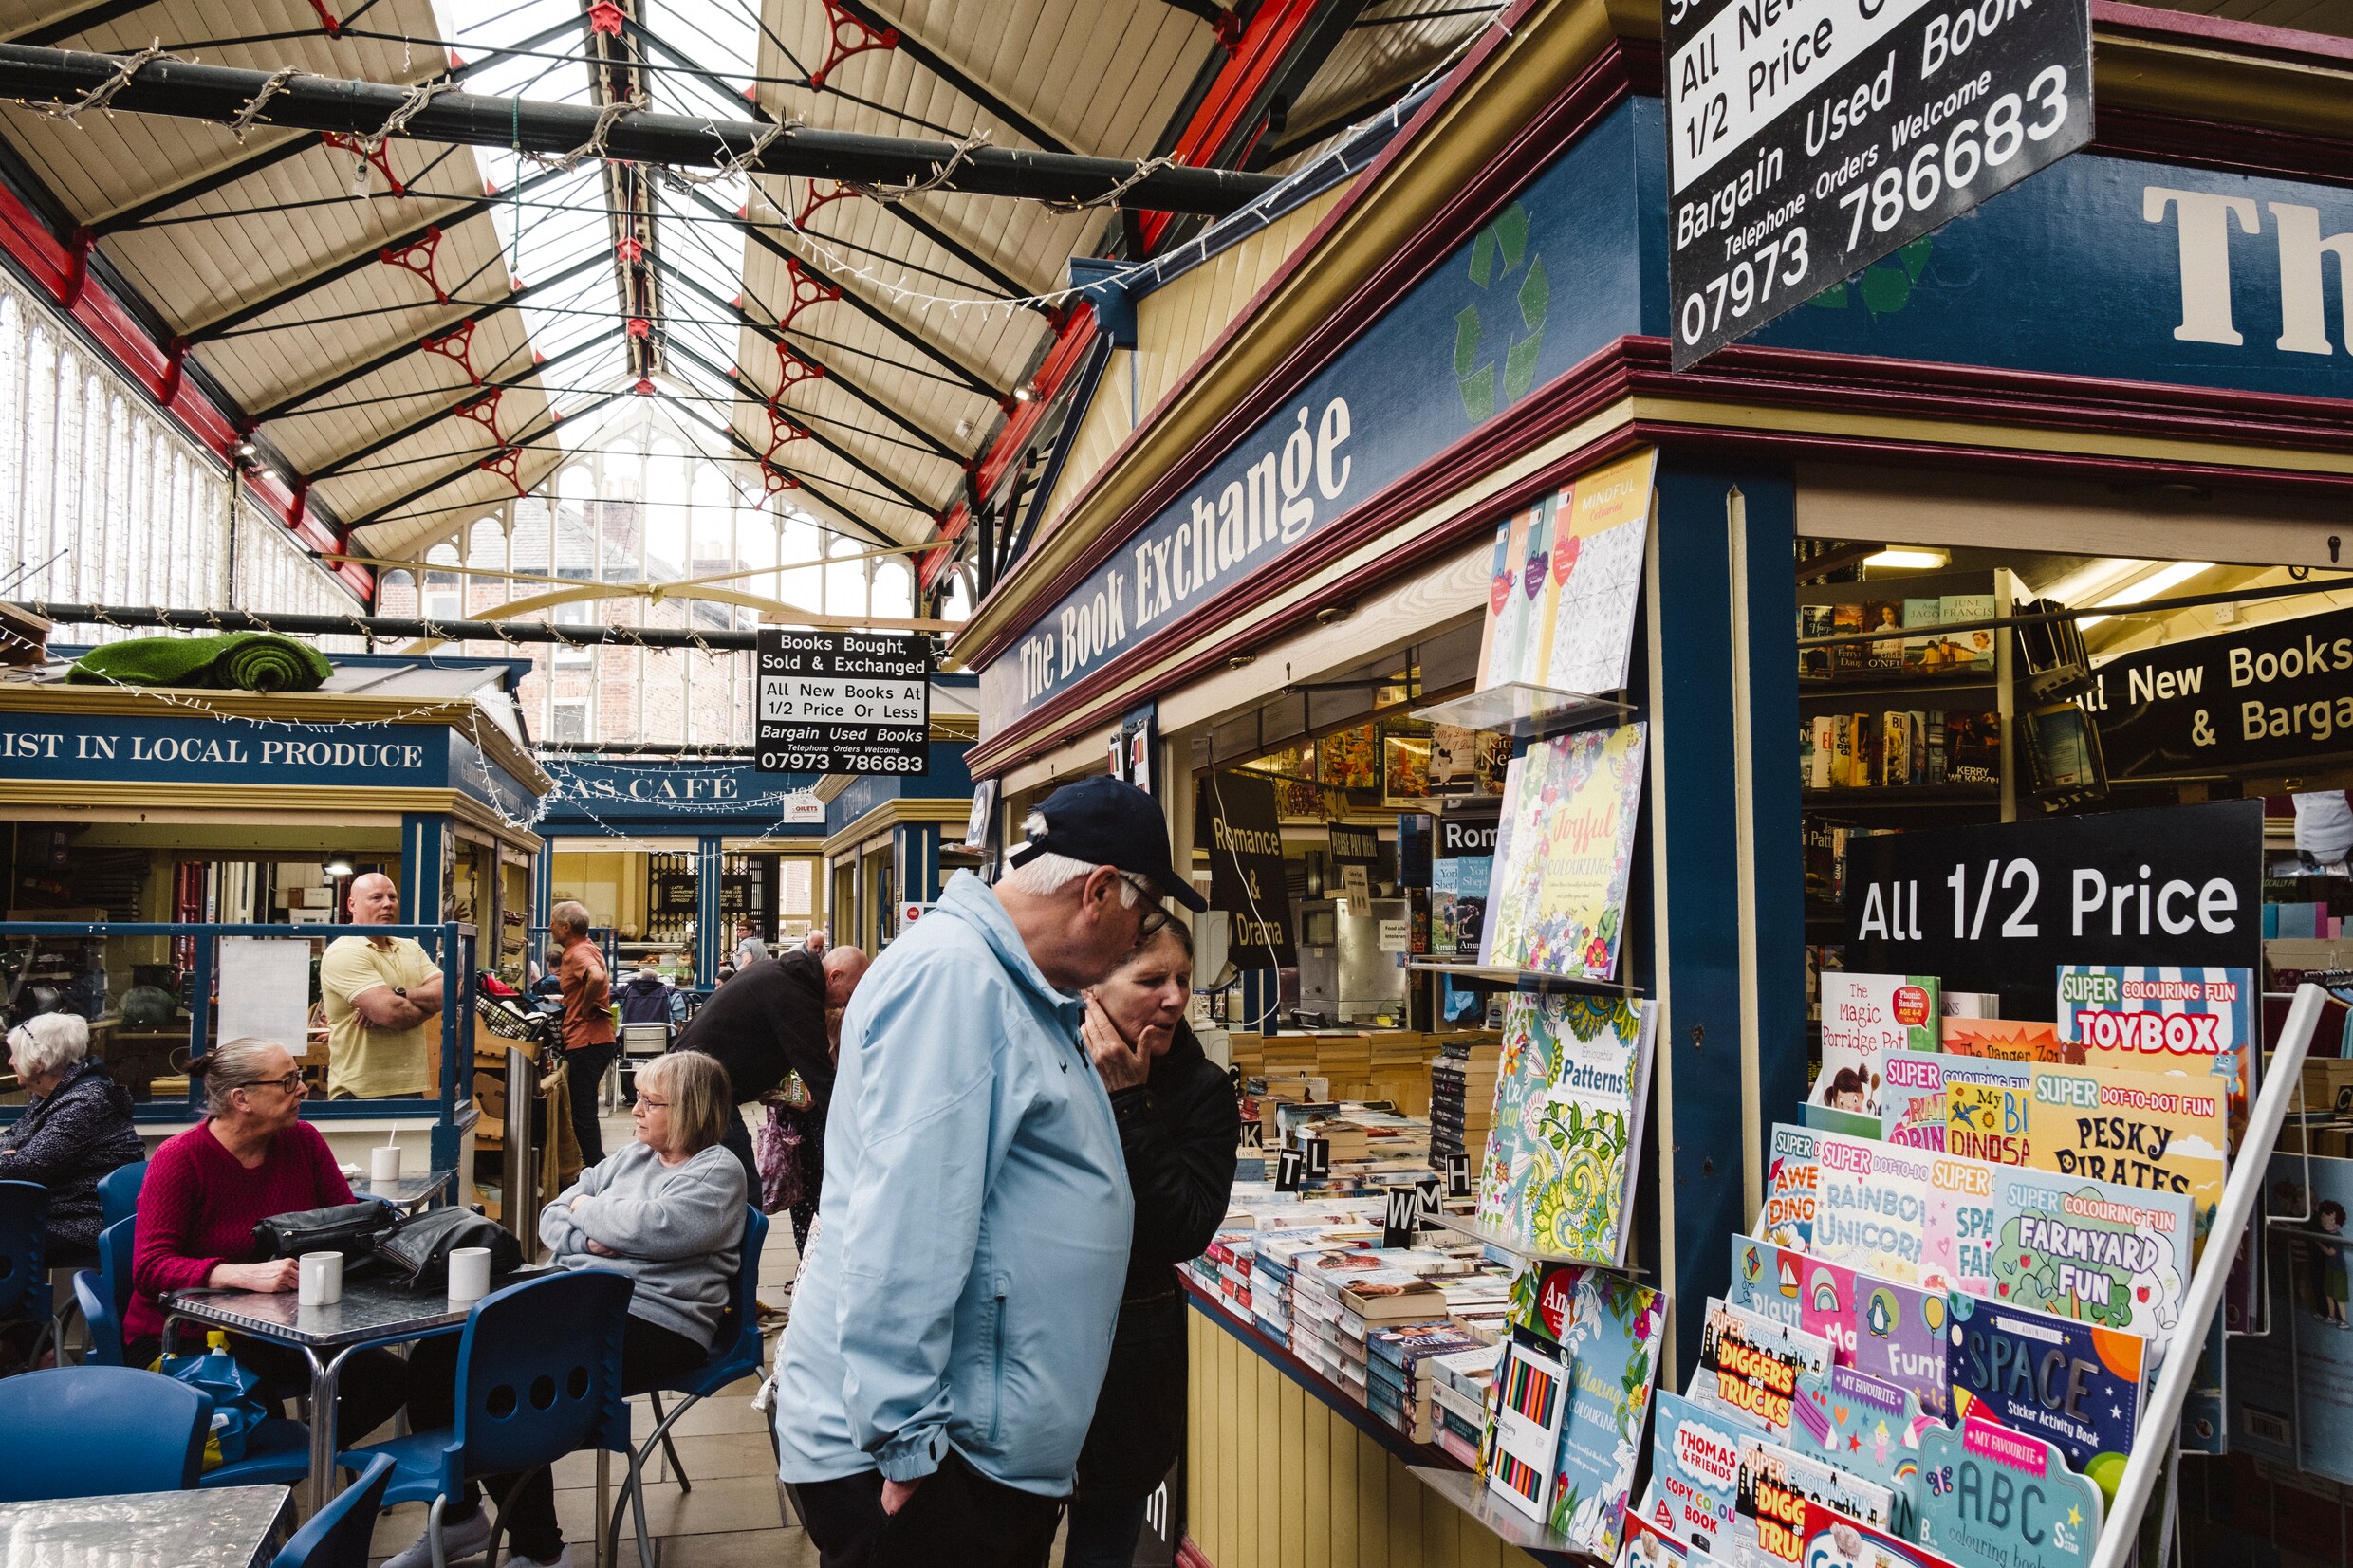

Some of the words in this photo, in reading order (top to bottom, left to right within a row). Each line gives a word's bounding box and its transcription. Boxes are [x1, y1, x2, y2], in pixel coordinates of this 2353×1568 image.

[1681, 32, 1719, 103] All
[1686, 92, 1728, 160] 1/2
[1748, 17, 1833, 112] Price
[1677, 147, 1783, 251] Bargain
[1806, 50, 1896, 157] Used
[1725, 194, 1805, 261] Telephone
[1816, 144, 1879, 199] Orders
[1891, 70, 1992, 151] Welcome
[1681, 226, 1809, 345] 07973
[1840, 65, 2068, 252] 786683
[1583, 478, 1635, 512] MINDFUL
[1019, 635, 1055, 705] The
[1060, 571, 1126, 681] Book
[1135, 397, 1352, 630] Exchange
[1943, 608, 1992, 617] FRANCIS
[1955, 599, 1981, 607] JUNE
[781, 635, 833, 652] Books
[843, 637, 907, 655] Bought,
[762, 654, 801, 670] Sold
[811, 656, 824, 671] &
[835, 656, 925, 676] Exchanged
[2128, 665, 2204, 705] New
[2230, 635, 2353, 689] Books
[767, 682, 789, 696] All
[800, 683, 835, 697] New
[844, 685, 894, 699] Books
[903, 687, 921, 700] At
[769, 701, 793, 715] 1/2
[804, 702, 843, 716] Price
[854, 704, 874, 717] Or
[884, 705, 918, 719] Less
[761, 725, 820, 741] Bargain
[829, 727, 867, 741] Used
[877, 729, 923, 742] Books
[2192, 709, 2216, 747] &
[76, 734, 120, 760] IN
[131, 736, 248, 764] LOCAL
[259, 740, 423, 768] PRODUCE
[761, 752, 830, 770] 07973
[843, 754, 923, 772] 786683
[787, 744, 828, 752] Telephone
[833, 745, 861, 753] Orders
[864, 745, 900, 754] Welcome
[629, 774, 738, 799] CAFÉ
[1956, 766, 1990, 777] KERRY
[1213, 817, 1279, 856] Romance
[1331, 831, 1350, 856] PLEASE
[1349, 833, 1362, 857] PAY
[1553, 802, 1617, 854] Joyful
[1547, 858, 1607, 876] COLOURING
[1250, 869, 1261, 900] &
[1858, 878, 1922, 941] All
[1947, 858, 2040, 941] 1/2
[2071, 864, 2238, 938] Price
[1236, 913, 1283, 946] Drama
[1850, 983, 1867, 998] The
[1898, 999, 1924, 1009] Readers
[1899, 989, 1921, 1000] Phonic
[2062, 974, 2119, 1004] SUPER
[2121, 982, 2201, 1002] COLOURING
[2204, 982, 2237, 1002] FUN
[1839, 1003, 1881, 1028] Magic
[1899, 1008, 1912, 1017] AGE
[1823, 1025, 1878, 1057] Porridge
[1882, 1029, 1905, 1049] Pot
[2076, 1010, 2219, 1055] TOYBOX
[1582, 1045, 1614, 1063] Enjoyable
[1960, 1043, 1982, 1058] The
[1987, 1045, 2031, 1062] Danger
[1562, 1059, 1624, 1094] Patterns
[1887, 1059, 1940, 1089] SUPER
[1943, 1070, 2007, 1087] COLOURING
[1977, 1089, 2002, 1109] My
[2036, 1075, 2099, 1108] SUPER
[2101, 1086, 2178, 1112] DOT-TO-DOT
[2182, 1098, 2215, 1117] FUN
[1243, 1124, 1260, 1148] K
[1775, 1130, 1813, 1159] SUPER
[1951, 1129, 2030, 1167] DINOSA
[2076, 1116, 2174, 1161] PESKY
[1282, 1153, 1300, 1185] T
[1312, 1143, 1325, 1172] L
[1449, 1158, 1470, 1190] H
[1821, 1141, 1873, 1175] SUPER
[2054, 1148, 2191, 1194] PIRATES
[1932, 1160, 1990, 1196] SUPER
[1389, 1191, 1416, 1230] W
[1416, 1184, 1444, 1217] M
[1769, 1197, 1816, 1226] DINO
[1827, 1182, 1925, 1227] RAINBO
[2007, 1183, 2060, 1214] SUPER
[2063, 1195, 2144, 1227] COLOURING
[2145, 1208, 2177, 1232] FUN
[2018, 1214, 2159, 1274] FARMYARD
[2058, 1263, 2111, 1307] FUN
[1710, 1308, 1746, 1339] SUPER
[1747, 1326, 1797, 1356] COLOURING
[1796, 1346, 1818, 1366] FUN
[1718, 1339, 1794, 1396] DIGGERS
[1748, 1375, 1764, 1391] and
[1968, 1330, 2100, 1424] SPACE
[1574, 1361, 1623, 1415] Relaxing
[1717, 1372, 1791, 1428] TRUCKS
[1841, 1374, 1854, 1390] MY
[1855, 1376, 1897, 1406] FAVOURITE
[1569, 1397, 1618, 1434] COLOURING
[2008, 1399, 2037, 1421] Sticker
[2039, 1410, 2074, 1437] Activity
[2075, 1426, 2100, 1448] Book
[1678, 1429, 1736, 1469] THOMAS
[1974, 1430, 1992, 1448] MY
[1992, 1433, 2037, 1465] FAVOURITE
[1682, 1451, 1689, 1462] &
[1689, 1453, 1732, 1482] FRIENDS
[1744, 1448, 1786, 1482] SUPER
[1788, 1469, 1850, 1504] COLOURING
[1849, 1493, 1874, 1514] FUN
[1665, 1476, 1694, 1503] COPY
[1958, 1460, 2047, 1546] ABC
[1684, 1506, 1717, 1535] BOOK
[1919, 1518, 1931, 1542] B
[2053, 1521, 2066, 1549] S
[1755, 1519, 1805, 1563] TRU
[1949, 1522, 2009, 1568] colouring
[2063, 1542, 2080, 1556] STAR
